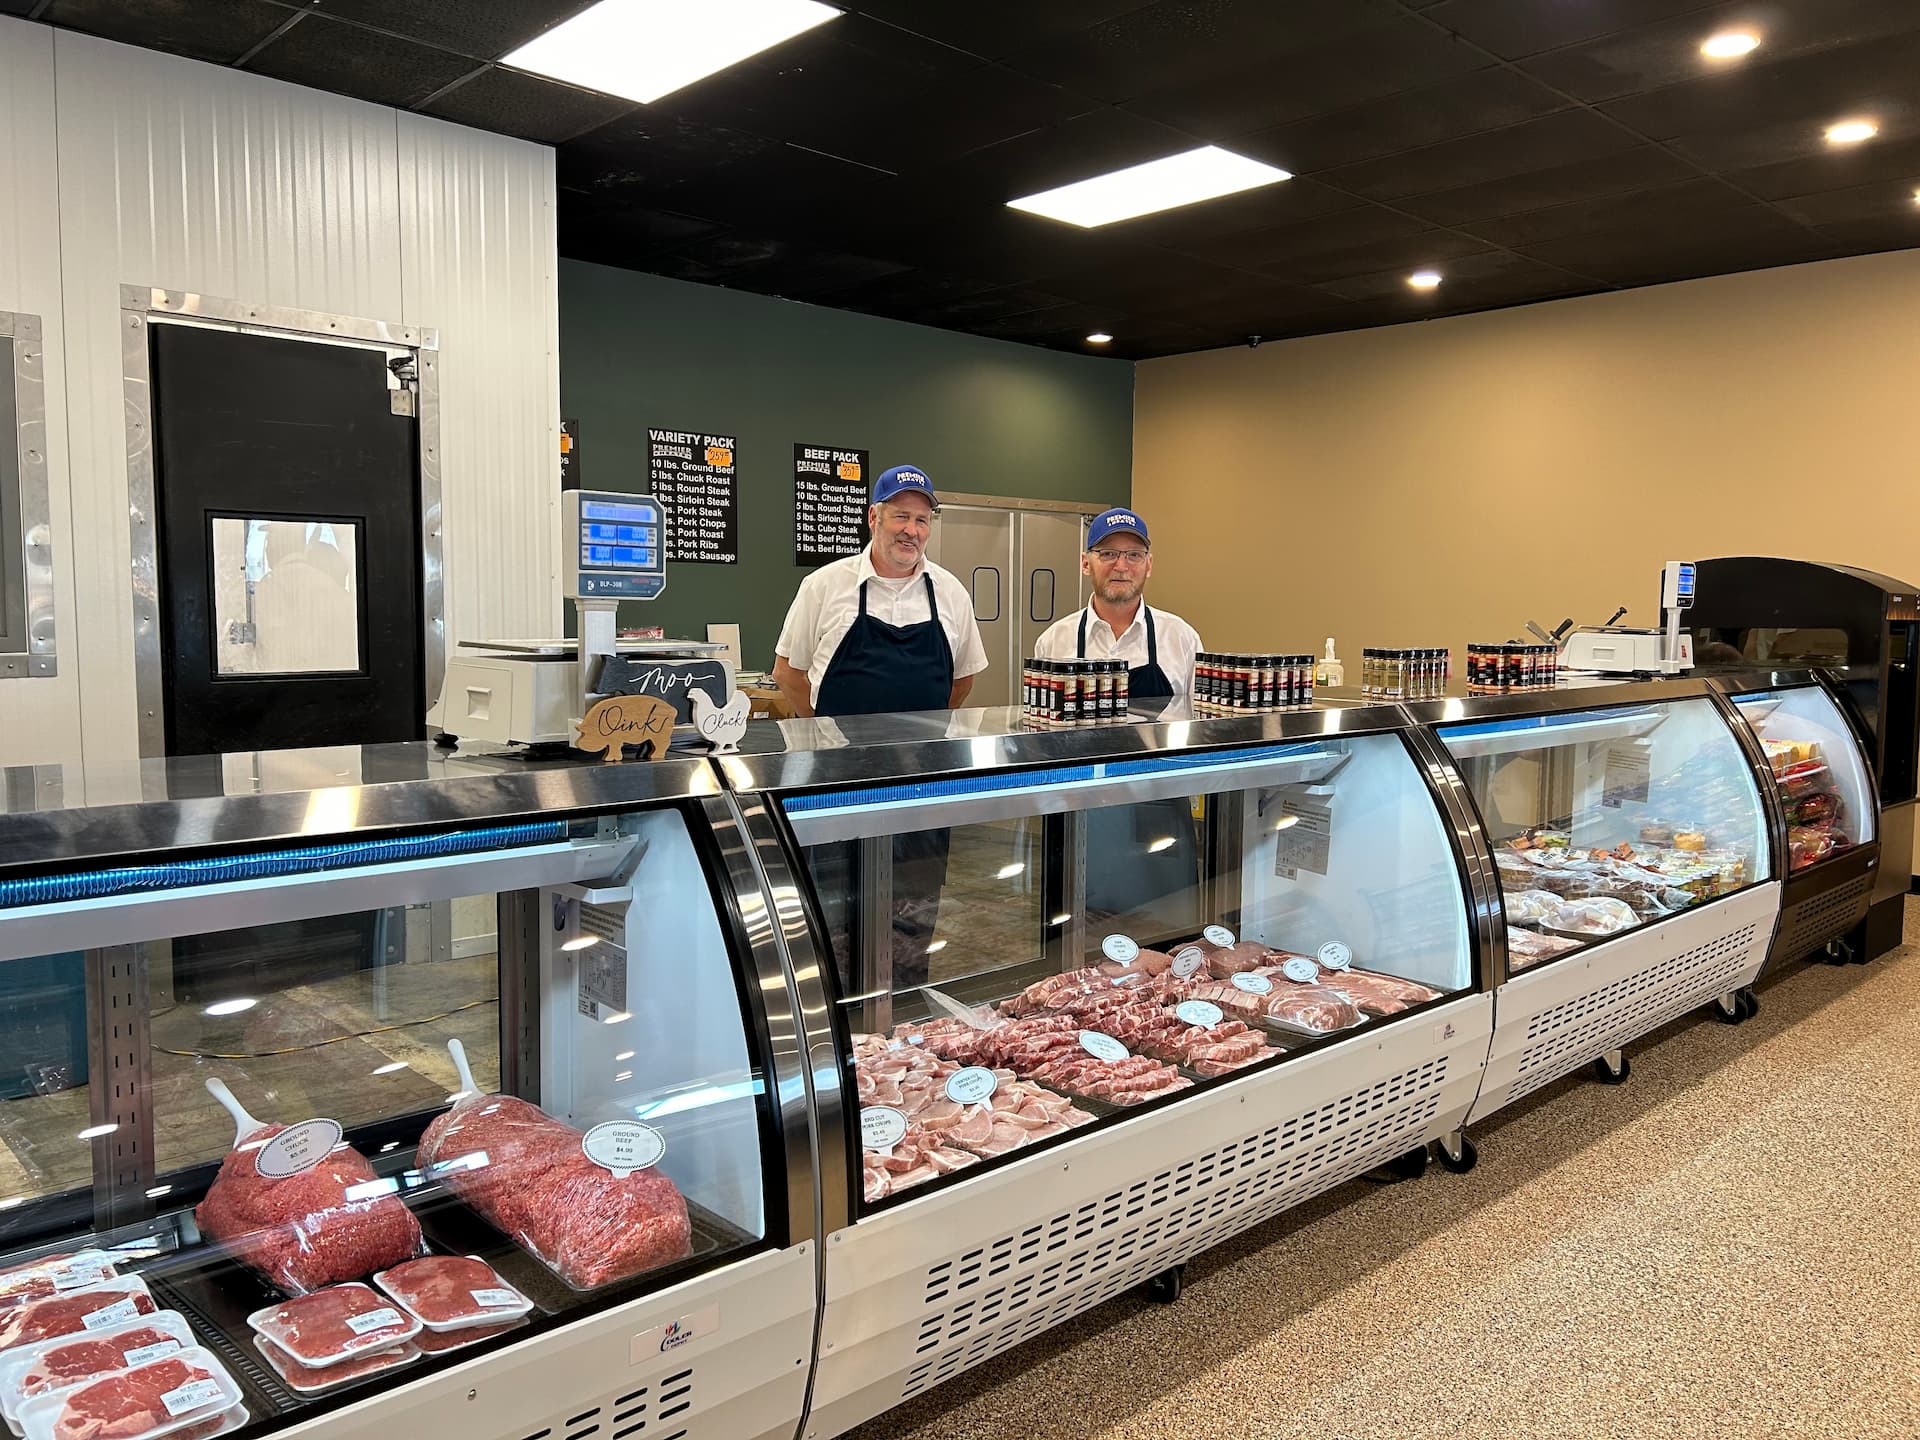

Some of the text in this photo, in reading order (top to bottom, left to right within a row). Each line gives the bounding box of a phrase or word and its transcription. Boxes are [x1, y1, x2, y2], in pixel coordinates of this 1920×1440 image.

[649, 429, 735, 449] VARIETY PACK
[652, 443, 693, 455] PREMIER
[804, 448, 860, 463] BEEF PACK
[651, 458, 735, 475] 10 lbs. Ground Beef
[796, 460, 831, 469] PREMIER
[651, 469, 731, 485] 5 lbs. Chuck Roast
[651, 481, 731, 496] 5 lbs. Round Steak
[796, 481, 867, 495] 15 lbs. Ground Beef
[659, 492, 675, 502] lbs.
[676, 494, 705, 505] Sirloin
[706, 496, 730, 507] Steak
[796, 491, 867, 505] 10 lbs. Chuck Roast
[677, 505, 698, 516] Pork
[699, 506, 723, 517] Steak
[796, 502, 863, 514] 5 lbs. Round Steak
[677, 516, 698, 527] Pork
[699, 518, 727, 529] Chops
[796, 512, 863, 524] 5 lbs. Sirloin Steak
[677, 528, 698, 538] Pork
[699, 528, 725, 539] Roast
[796, 522, 858, 534] 5 lbs. Cube Steak
[677, 539, 698, 549] Pork
[699, 539, 719, 550] Ribs
[796, 533, 860, 544] 5 lbs. Beef Patties
[796, 543, 861, 554] 5 lbs. Beef Brisket
[677, 549, 698, 560] Pork
[699, 551, 736, 563] Sausage
[628, 667, 716, 694] Moo
[598, 704, 670, 737] Oink
[702, 711, 747, 735] Cluck
[280, 1128, 310, 1146] GROUND
[612, 1130, 640, 1138] GROUND
[284, 1137, 310, 1152] CHUCK
